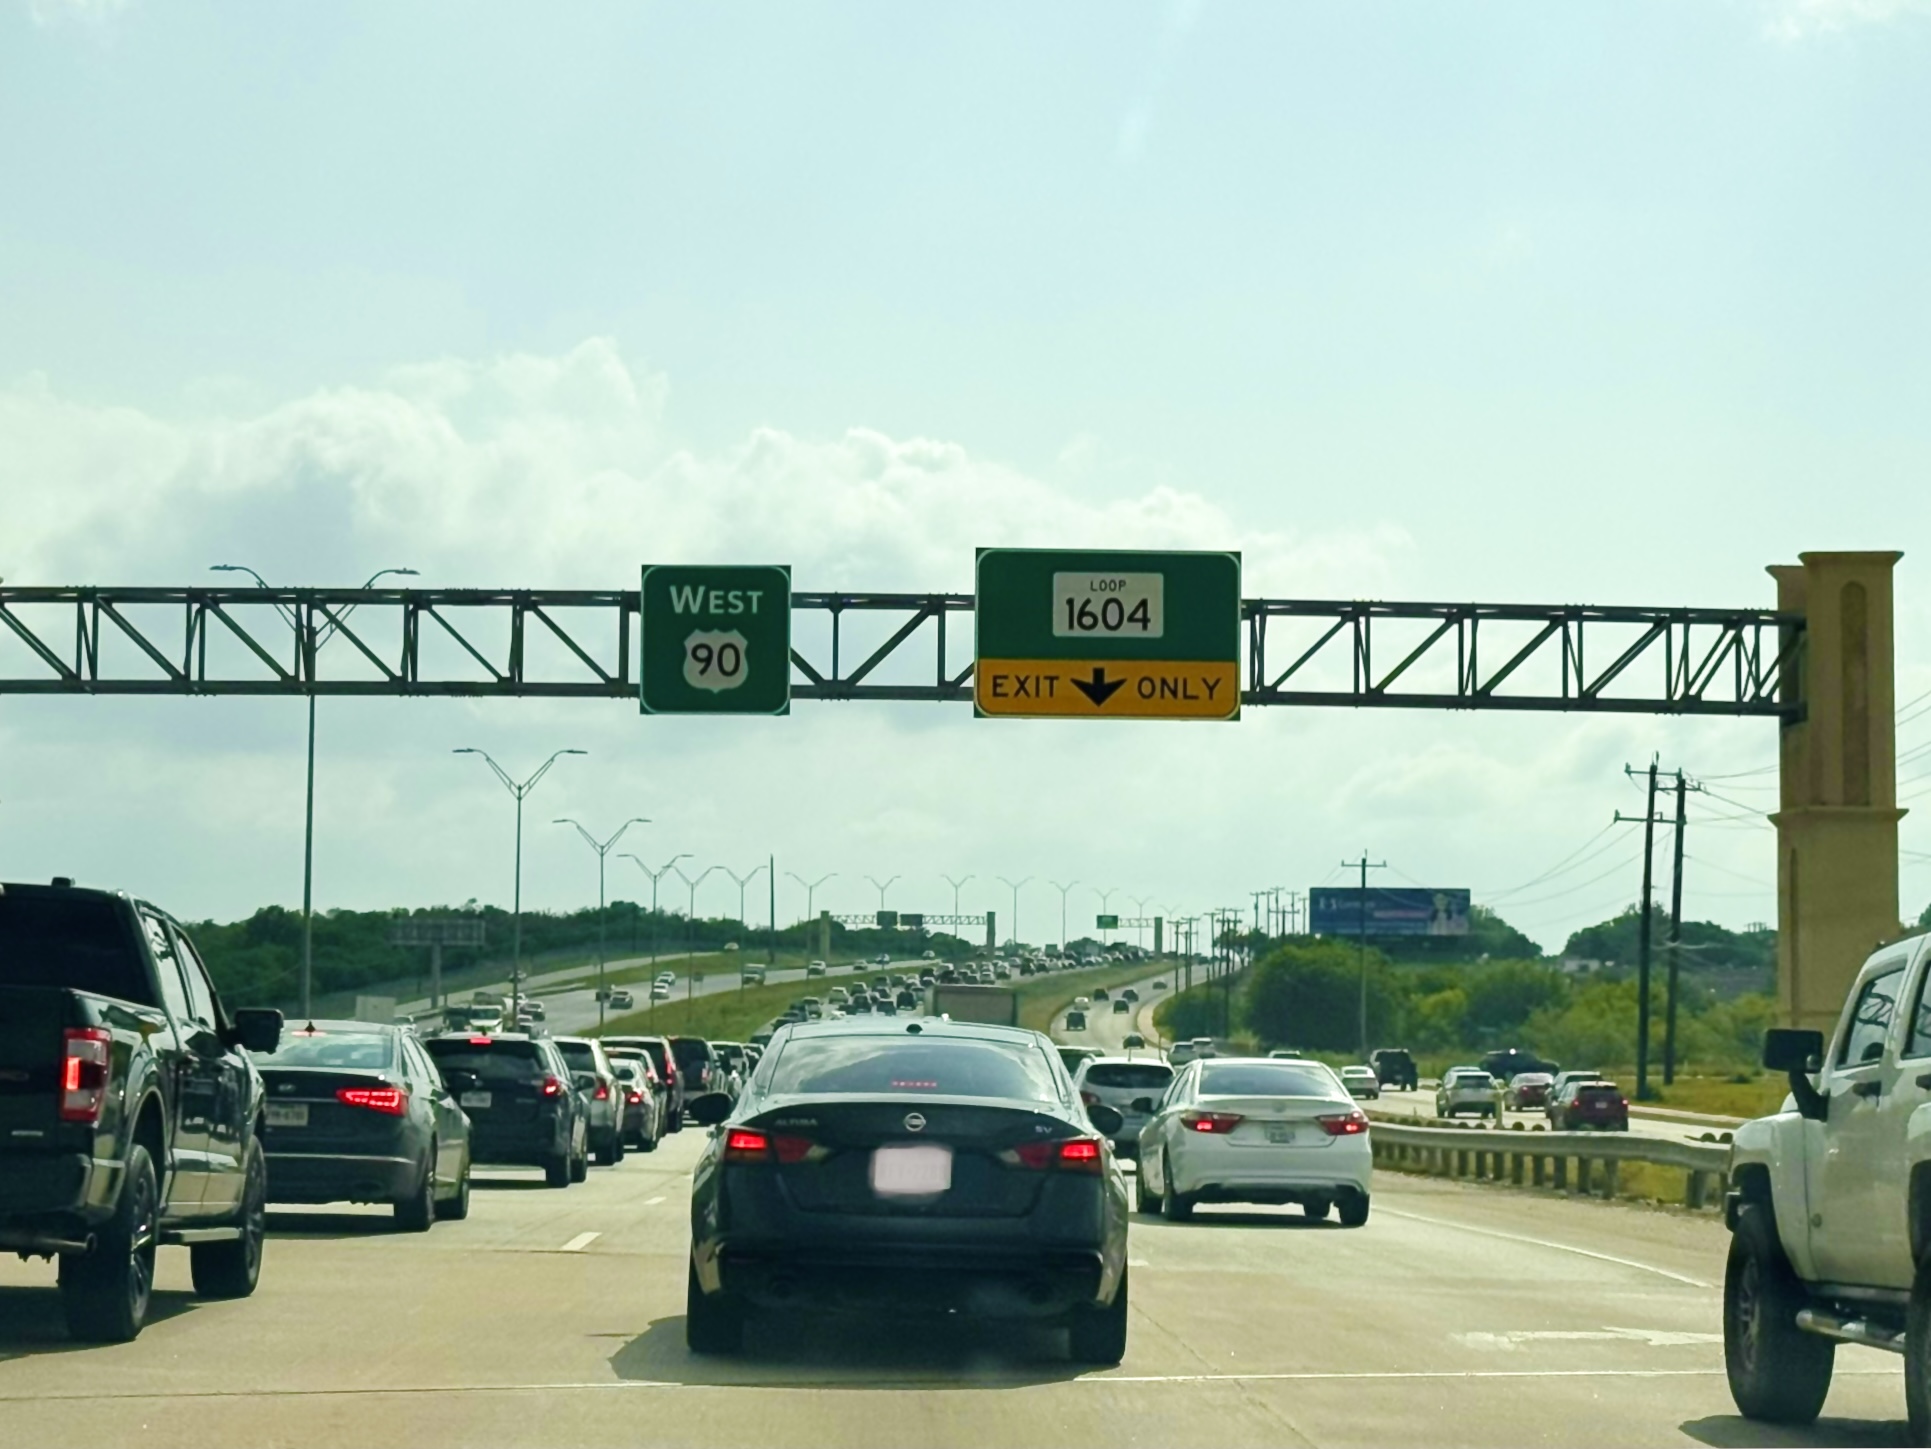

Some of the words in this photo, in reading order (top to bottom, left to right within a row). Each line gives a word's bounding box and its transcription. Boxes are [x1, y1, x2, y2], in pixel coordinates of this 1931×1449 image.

[669, 585, 763, 614] WEST
[1090, 579, 1127, 592] LOOP
[1065, 597, 1151, 631] 1604
[691, 642, 741, 677] 90
[992, 675, 1060, 698] EXIT
[1137, 677, 1222, 700] ONLY
